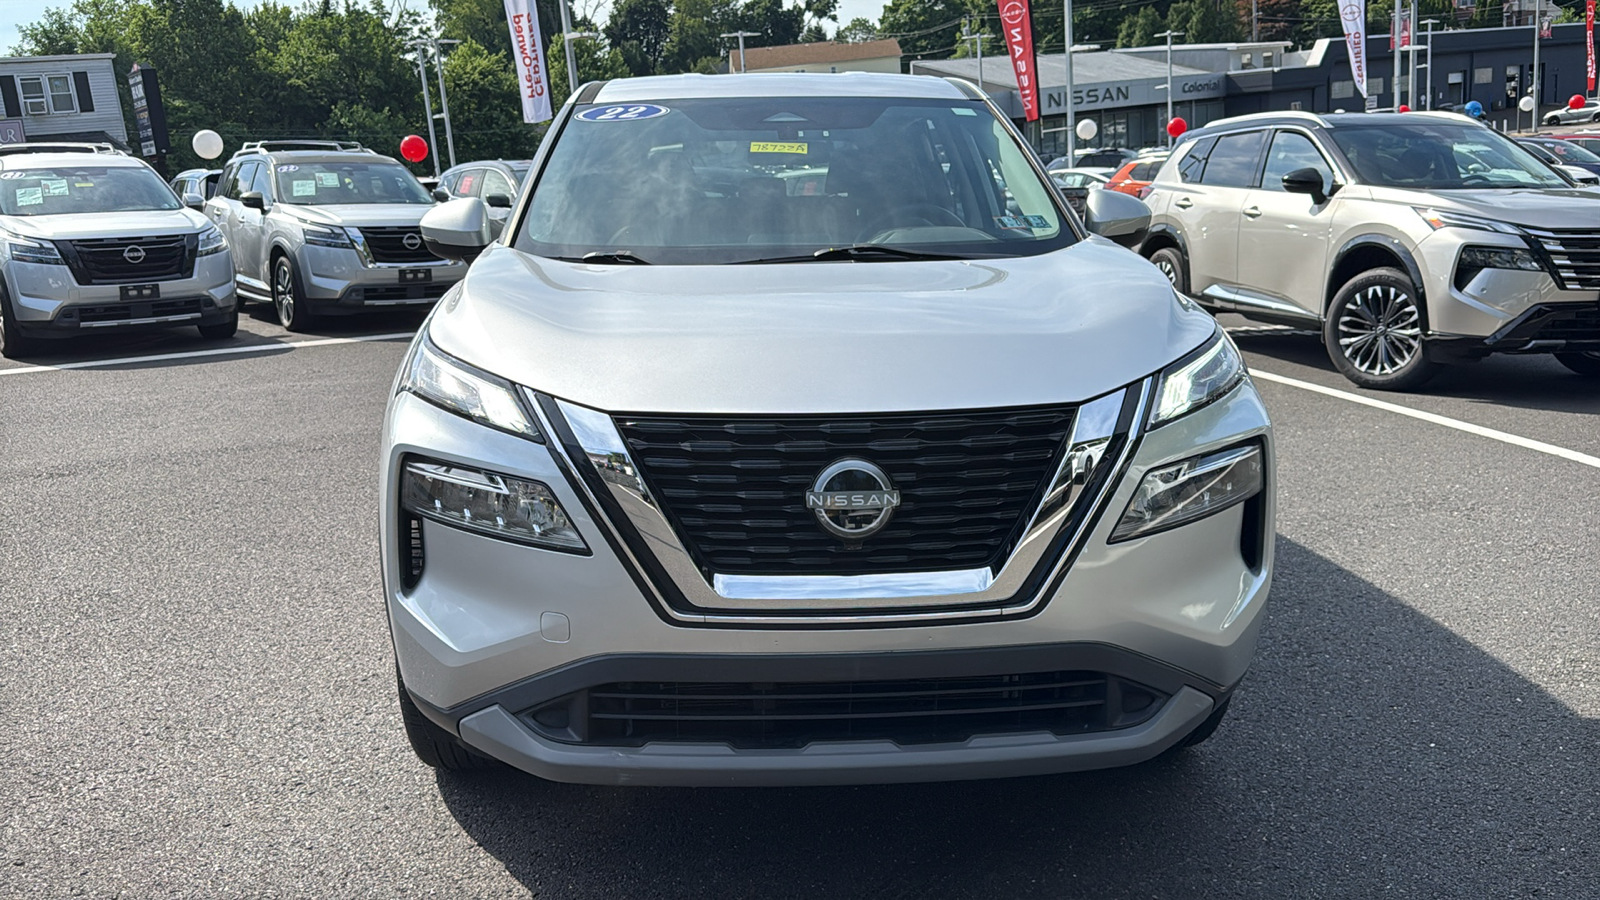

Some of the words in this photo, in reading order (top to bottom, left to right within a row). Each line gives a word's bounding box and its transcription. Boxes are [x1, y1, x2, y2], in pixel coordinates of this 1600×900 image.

[1182, 79, 1220, 94] Colonial
[1048, 86, 1129, 108] NISSAN
[596, 106, 648, 120] 22
[752, 143, 806, 152] 78722A
[809, 493, 897, 506] NISSAN
